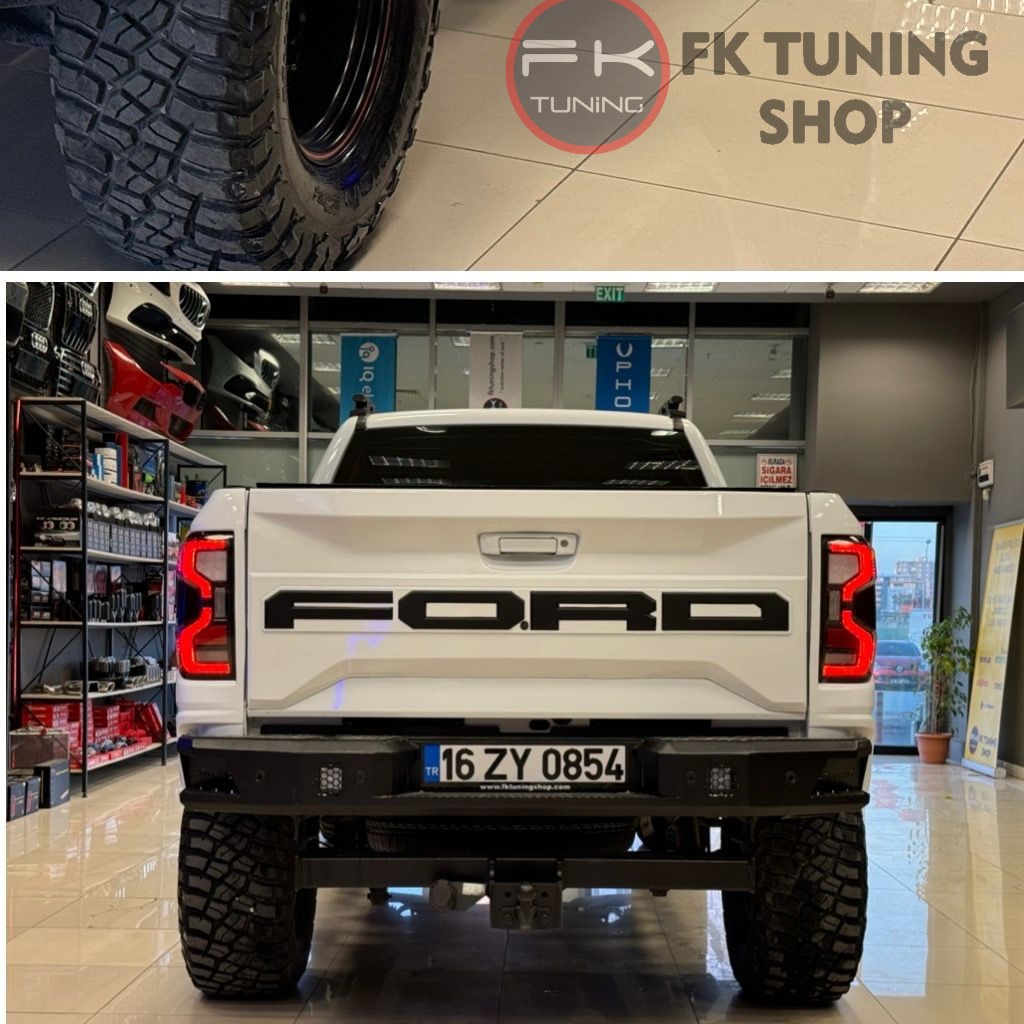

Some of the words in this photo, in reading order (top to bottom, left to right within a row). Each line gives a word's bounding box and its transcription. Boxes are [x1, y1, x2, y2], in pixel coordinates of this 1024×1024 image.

[596, 287, 623, 302] EXIT
[263, 589, 790, 632] FORD
[426, 767, 439, 777] TR
[442, 748, 475, 780] 16
[484, 748, 532, 780] ZY
[542, 748, 624, 781] 0854
[480, 783, 571, 792] www.fktuningshop.com
